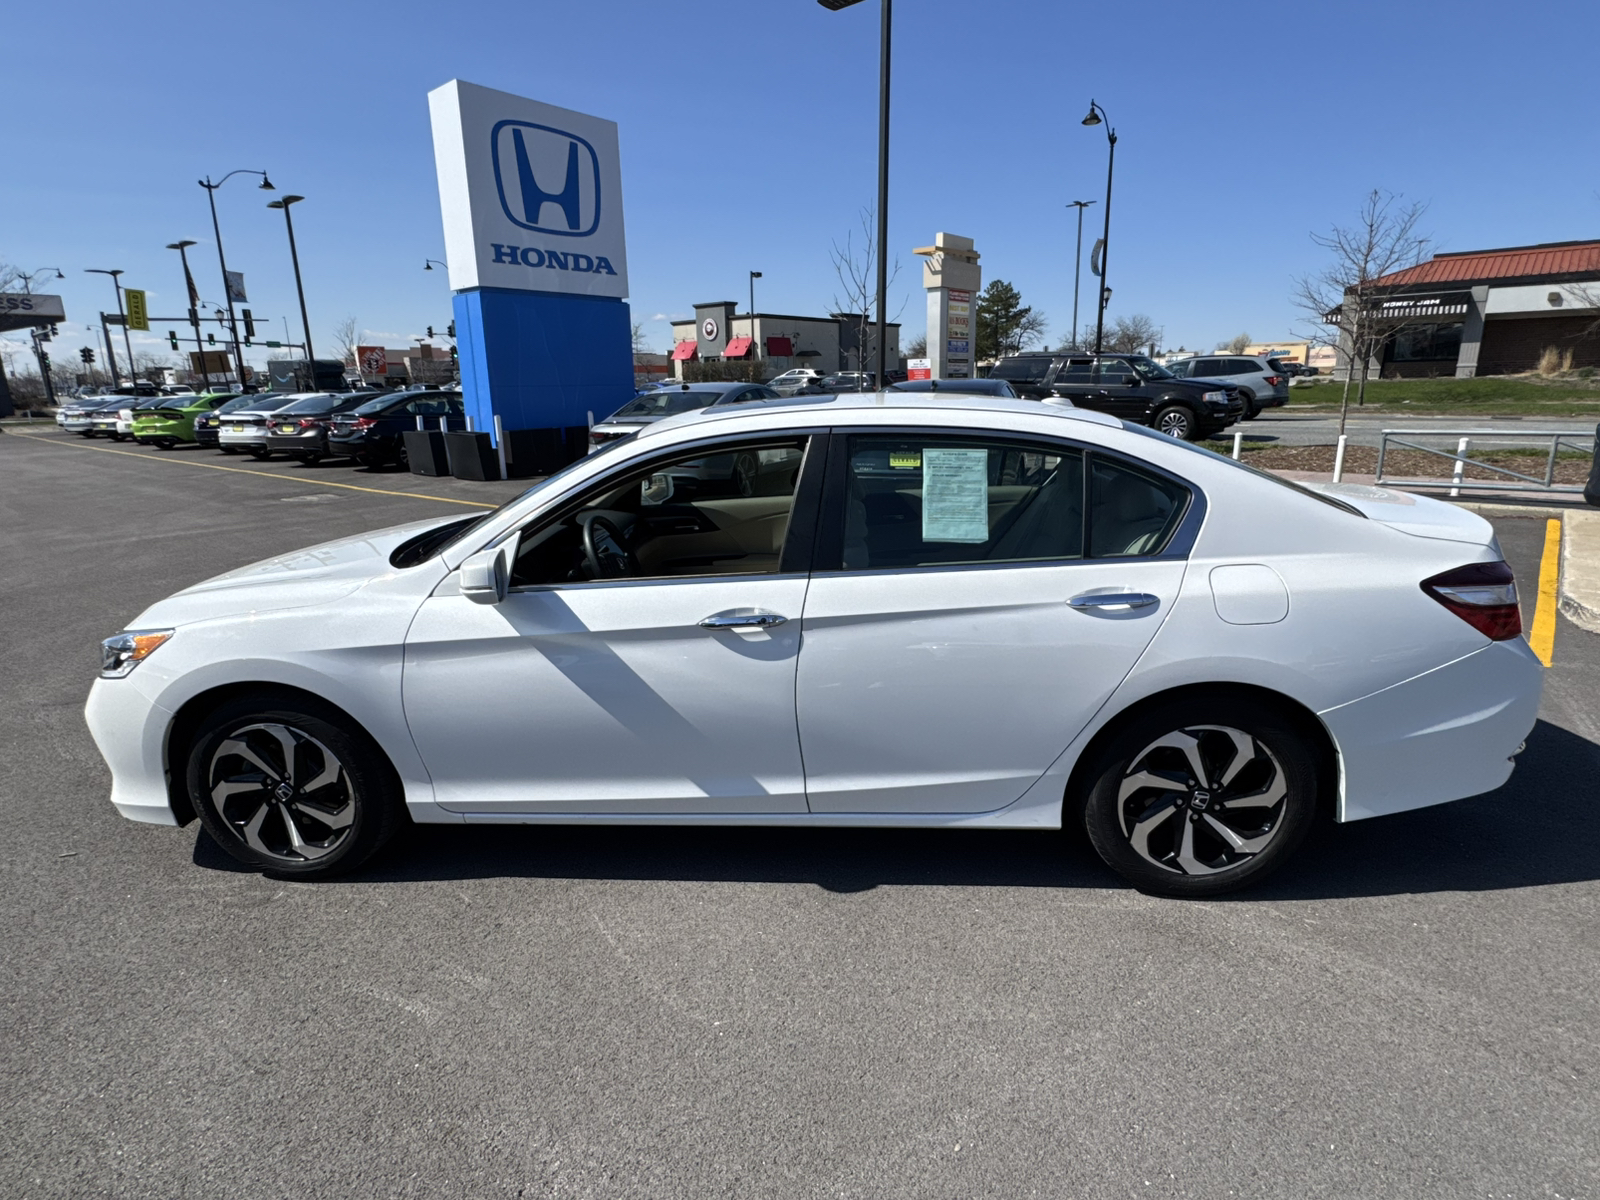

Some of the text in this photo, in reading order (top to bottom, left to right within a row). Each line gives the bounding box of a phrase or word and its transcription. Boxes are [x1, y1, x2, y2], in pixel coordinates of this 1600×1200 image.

[490, 242, 618, 276] HONDA
[132, 294, 142, 326] GERALD
[1382, 298, 1441, 308] HONEY JAM
